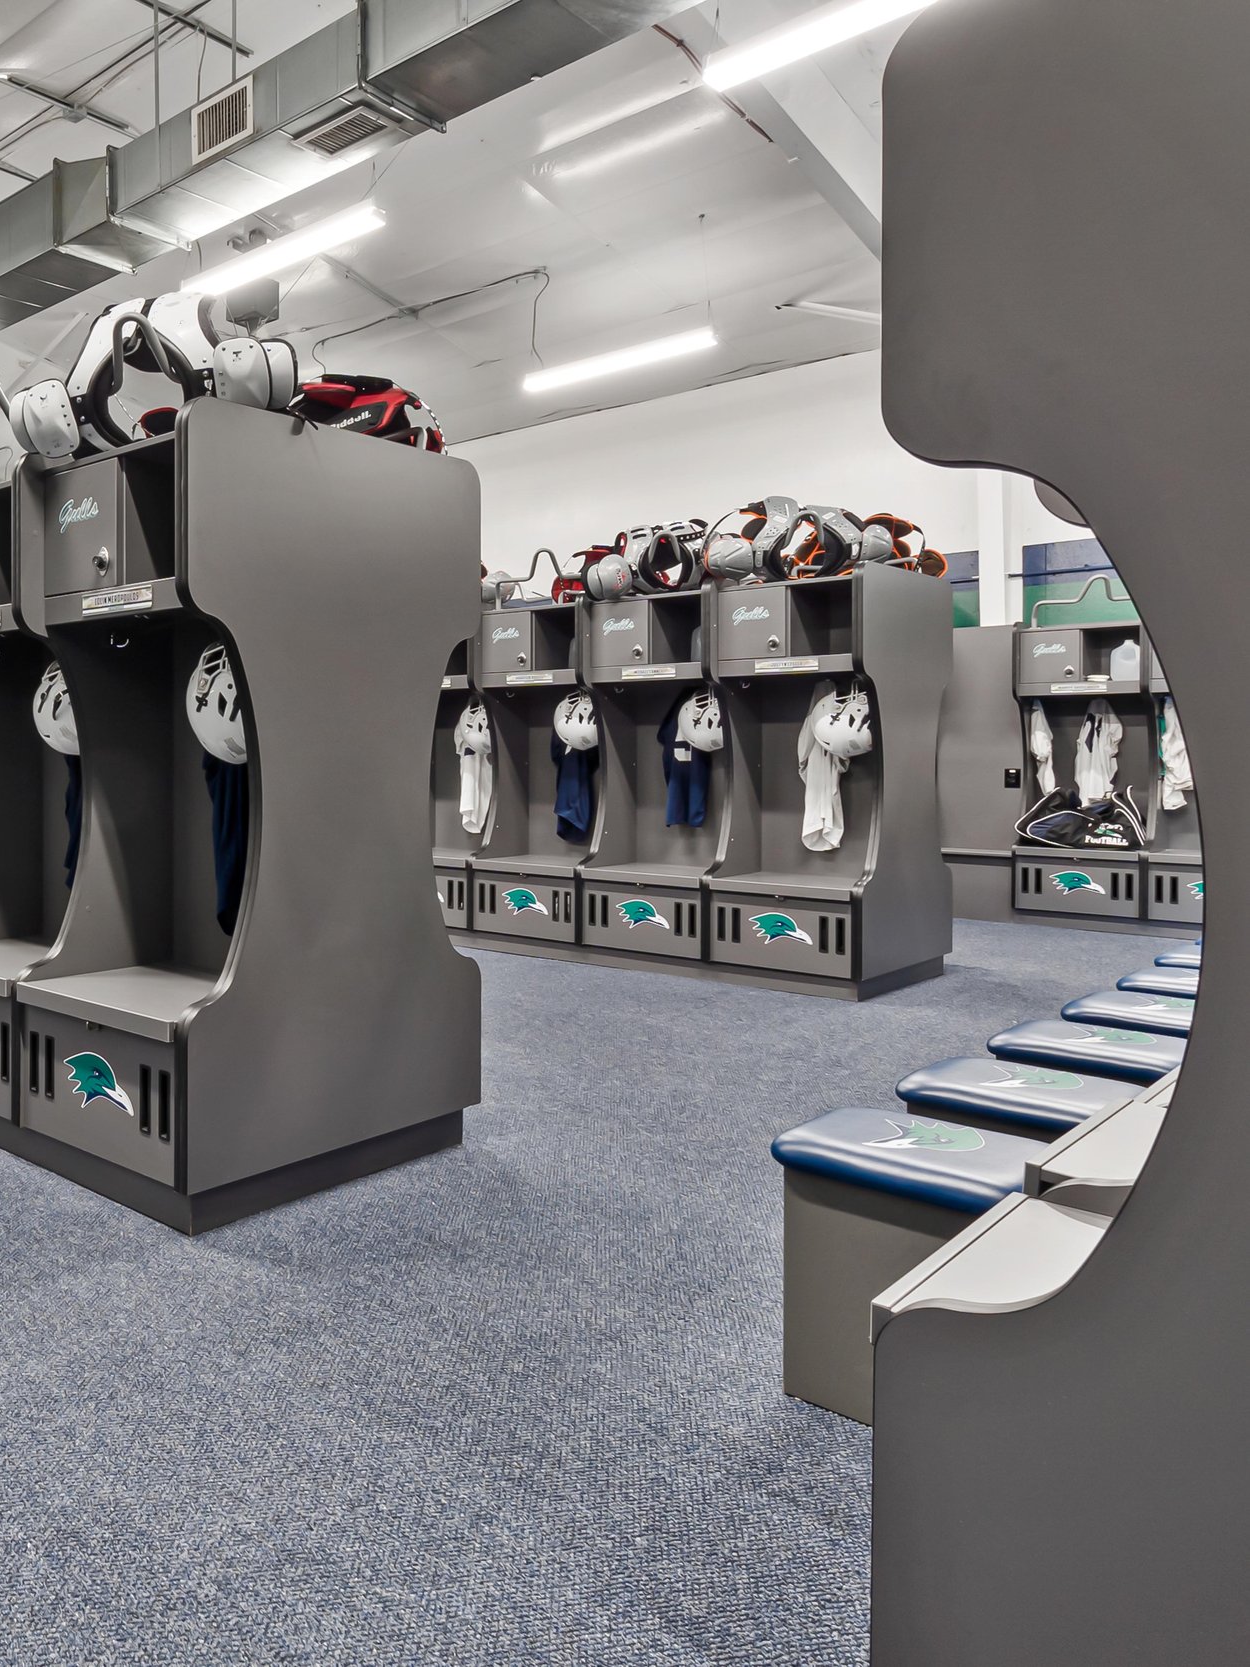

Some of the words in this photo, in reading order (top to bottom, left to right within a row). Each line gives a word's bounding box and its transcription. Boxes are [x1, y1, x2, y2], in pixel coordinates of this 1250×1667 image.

[59, 497, 99, 534] Gulls
[732, 606, 770, 627] Gulls
[492, 627, 520, 644] Gulls
[602, 618, 635, 636] Gulls
[1033, 643, 1067, 658] Gulls
[1084, 835, 1129, 846] FOOTBALL
